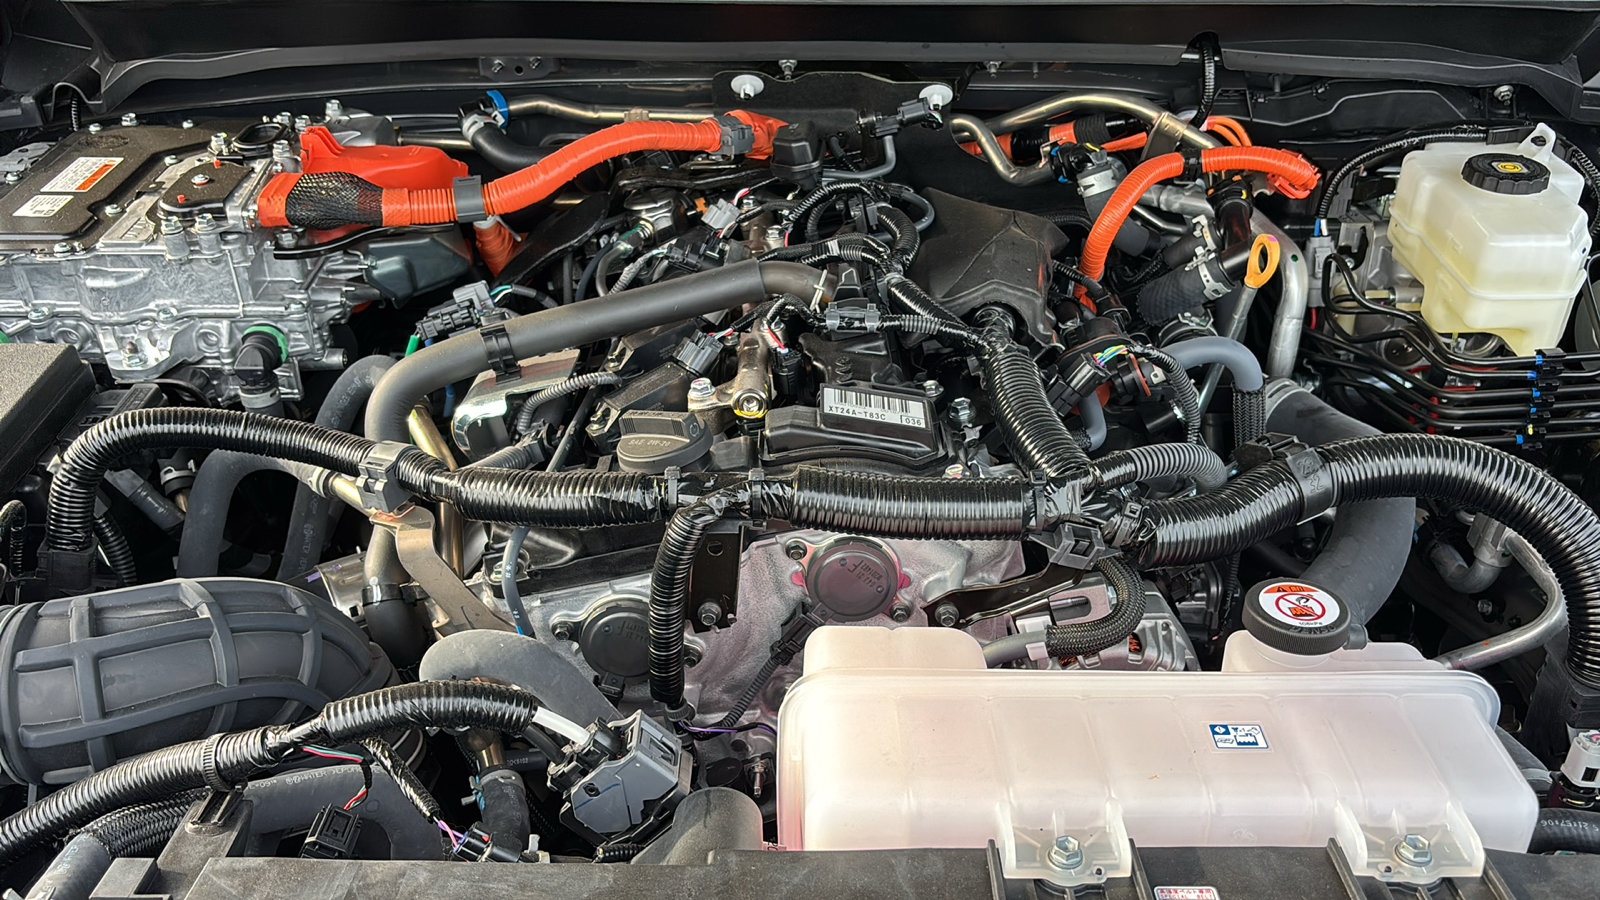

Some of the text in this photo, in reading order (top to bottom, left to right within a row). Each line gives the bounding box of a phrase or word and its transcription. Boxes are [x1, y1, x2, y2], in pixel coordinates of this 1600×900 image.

[828, 405, 887, 421] XT24A-T83C
[904, 417, 922, 426] 036
[647, 439, 672, 447] 0W-20
[1289, 624, 1337, 635] DENSO
[301, 770, 329, 781] WATER
